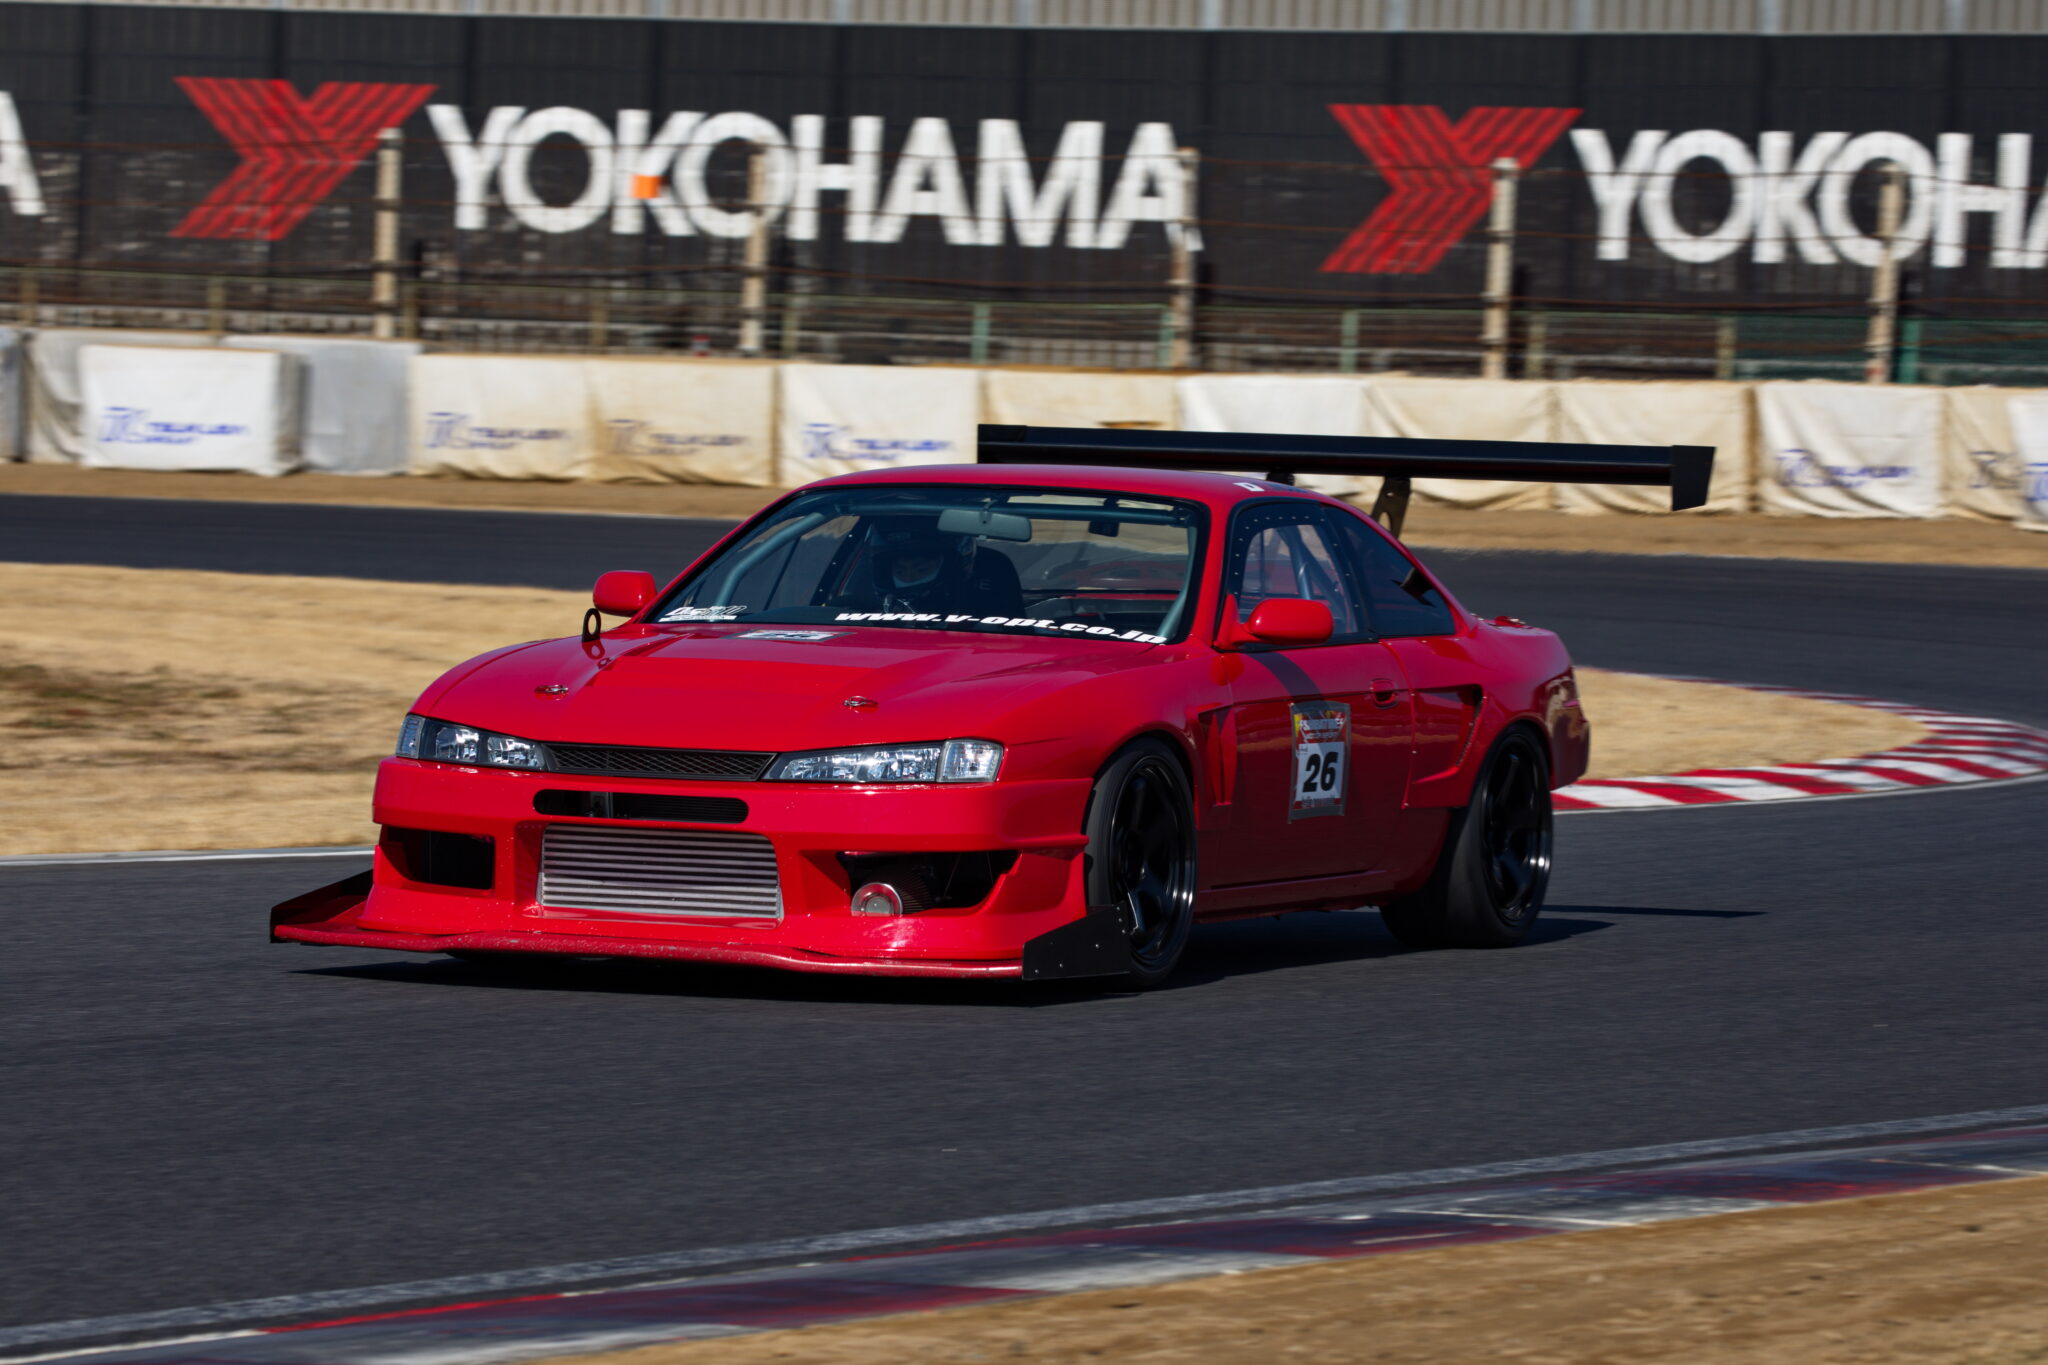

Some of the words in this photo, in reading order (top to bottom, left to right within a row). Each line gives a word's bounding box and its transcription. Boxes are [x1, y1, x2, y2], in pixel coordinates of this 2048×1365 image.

[427, 103, 1204, 252] YOKOHAMA
[1569, 128, 2048, 271] YOKOH
[834, 612, 1168, 645] www.v-opt.co.jp
[1302, 751, 1339, 793] 26
